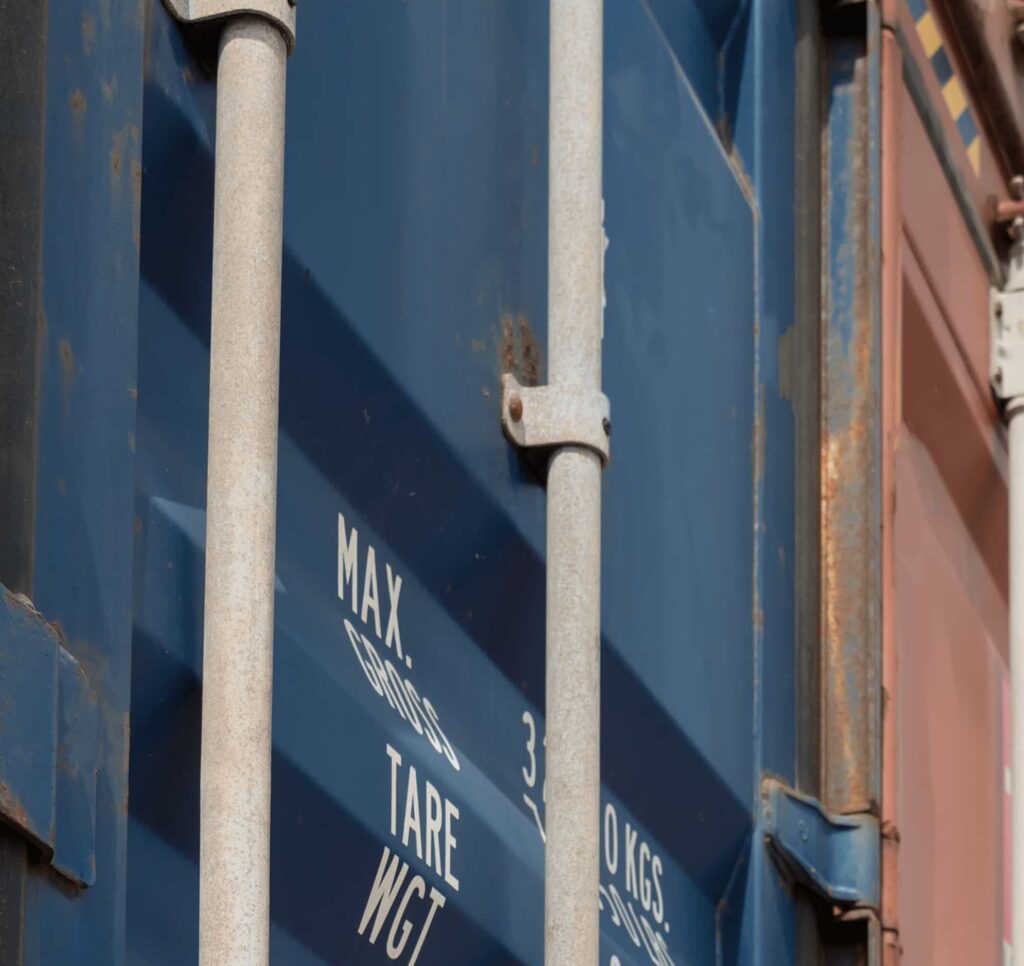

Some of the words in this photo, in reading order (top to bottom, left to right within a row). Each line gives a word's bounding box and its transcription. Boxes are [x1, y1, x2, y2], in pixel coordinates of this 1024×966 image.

[337, 512, 412, 669] MAX.
[343, 618, 461, 772] GROSS
[386, 743, 460, 892] TARE
[625, 822, 670, 933] KGS.
